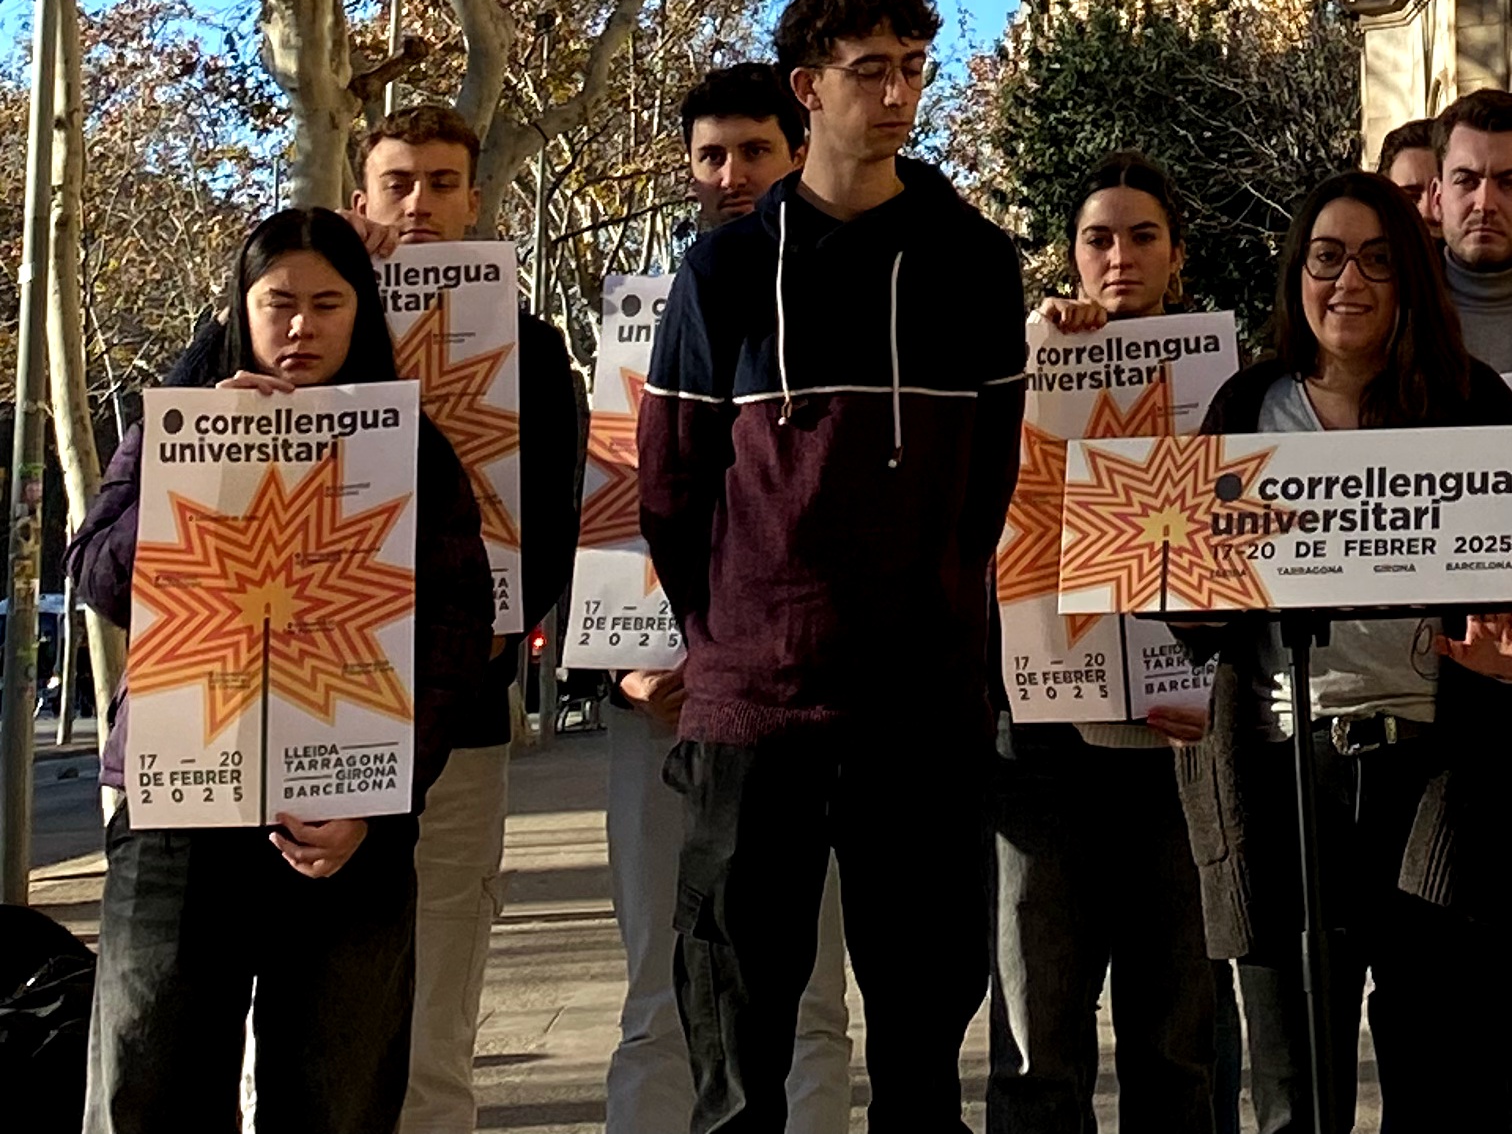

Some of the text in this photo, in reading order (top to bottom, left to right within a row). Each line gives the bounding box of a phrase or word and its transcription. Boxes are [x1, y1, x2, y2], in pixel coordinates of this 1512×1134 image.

[1036, 335, 1220, 366] correllengua
[1025, 358, 1166, 392] niversitari
[194, 407, 400, 436] correllengua
[160, 435, 339, 463] universitari
[1258, 467, 1512, 502] correllengua
[1211, 499, 1440, 535] universitari
[1295, 540, 1327, 559] DE
[1344, 538, 1437, 557] FEBRER
[1453, 535, 1512, 554] 2025
[585, 600, 601, 615] 17
[659, 600, 670, 615] 2
[583, 616, 607, 631] DE
[1142, 644, 1183, 658] LLEID
[1014, 656, 1029, 670] 17
[1084, 653, 1105, 667] 20
[1015, 669, 1107, 686] DE FEBRER
[1145, 677, 1212, 695] BARCEL
[139, 754, 158, 770] 17
[220, 751, 243, 767] 20
[284, 743, 339, 759] LLEIDA
[284, 753, 398, 773] TARRAGONA
[139, 770, 242, 787] DE FEBRER
[335, 766, 397, 782] GIRONA
[284, 777, 397, 800] BARCELONA
